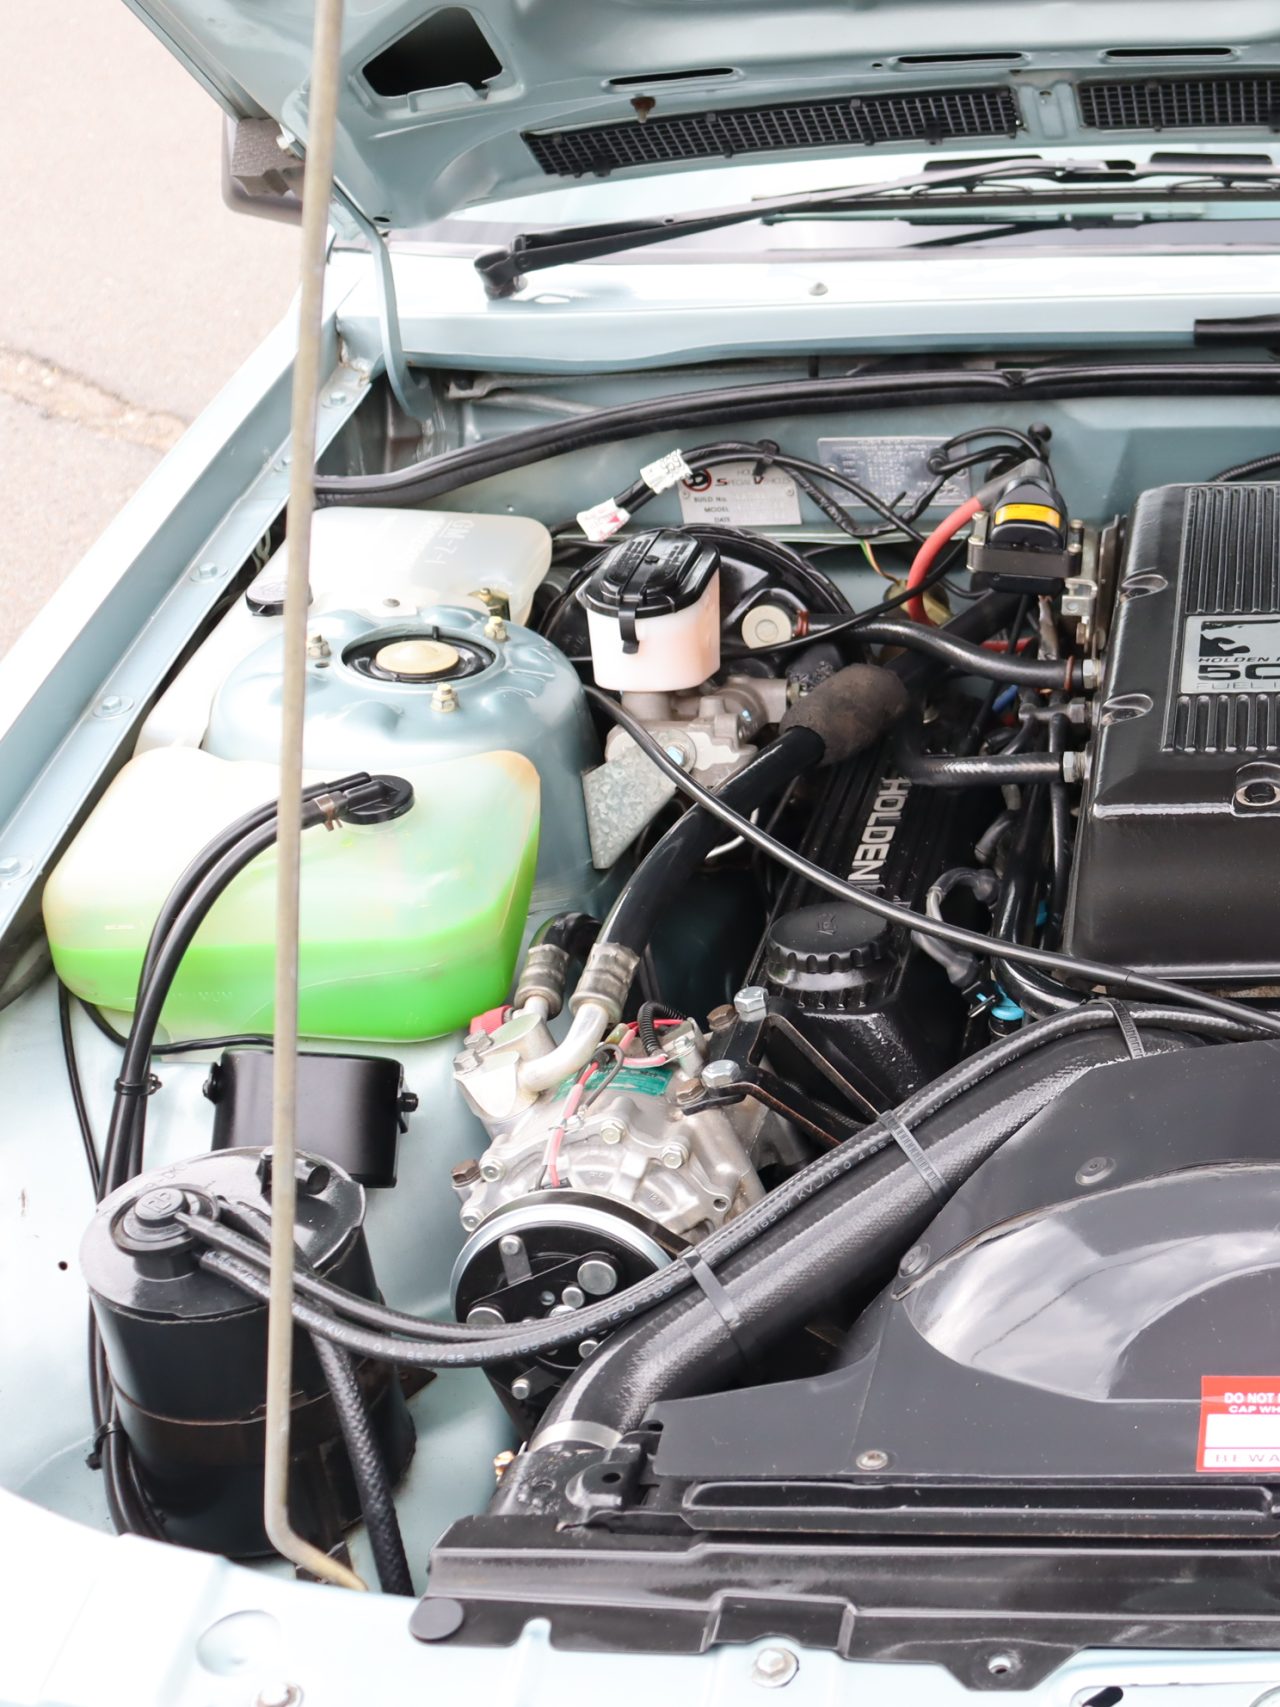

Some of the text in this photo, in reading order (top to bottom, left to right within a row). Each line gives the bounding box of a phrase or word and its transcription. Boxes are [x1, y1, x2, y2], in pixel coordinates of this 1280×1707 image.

[1197, 655, 1272, 664] HOLDEN
[848, 776, 912, 883] HOLDEN
[1223, 1392, 1245, 1404] DO
[1247, 1392, 1275, 1404] NOT
[1228, 1405, 1256, 1414] CAP
